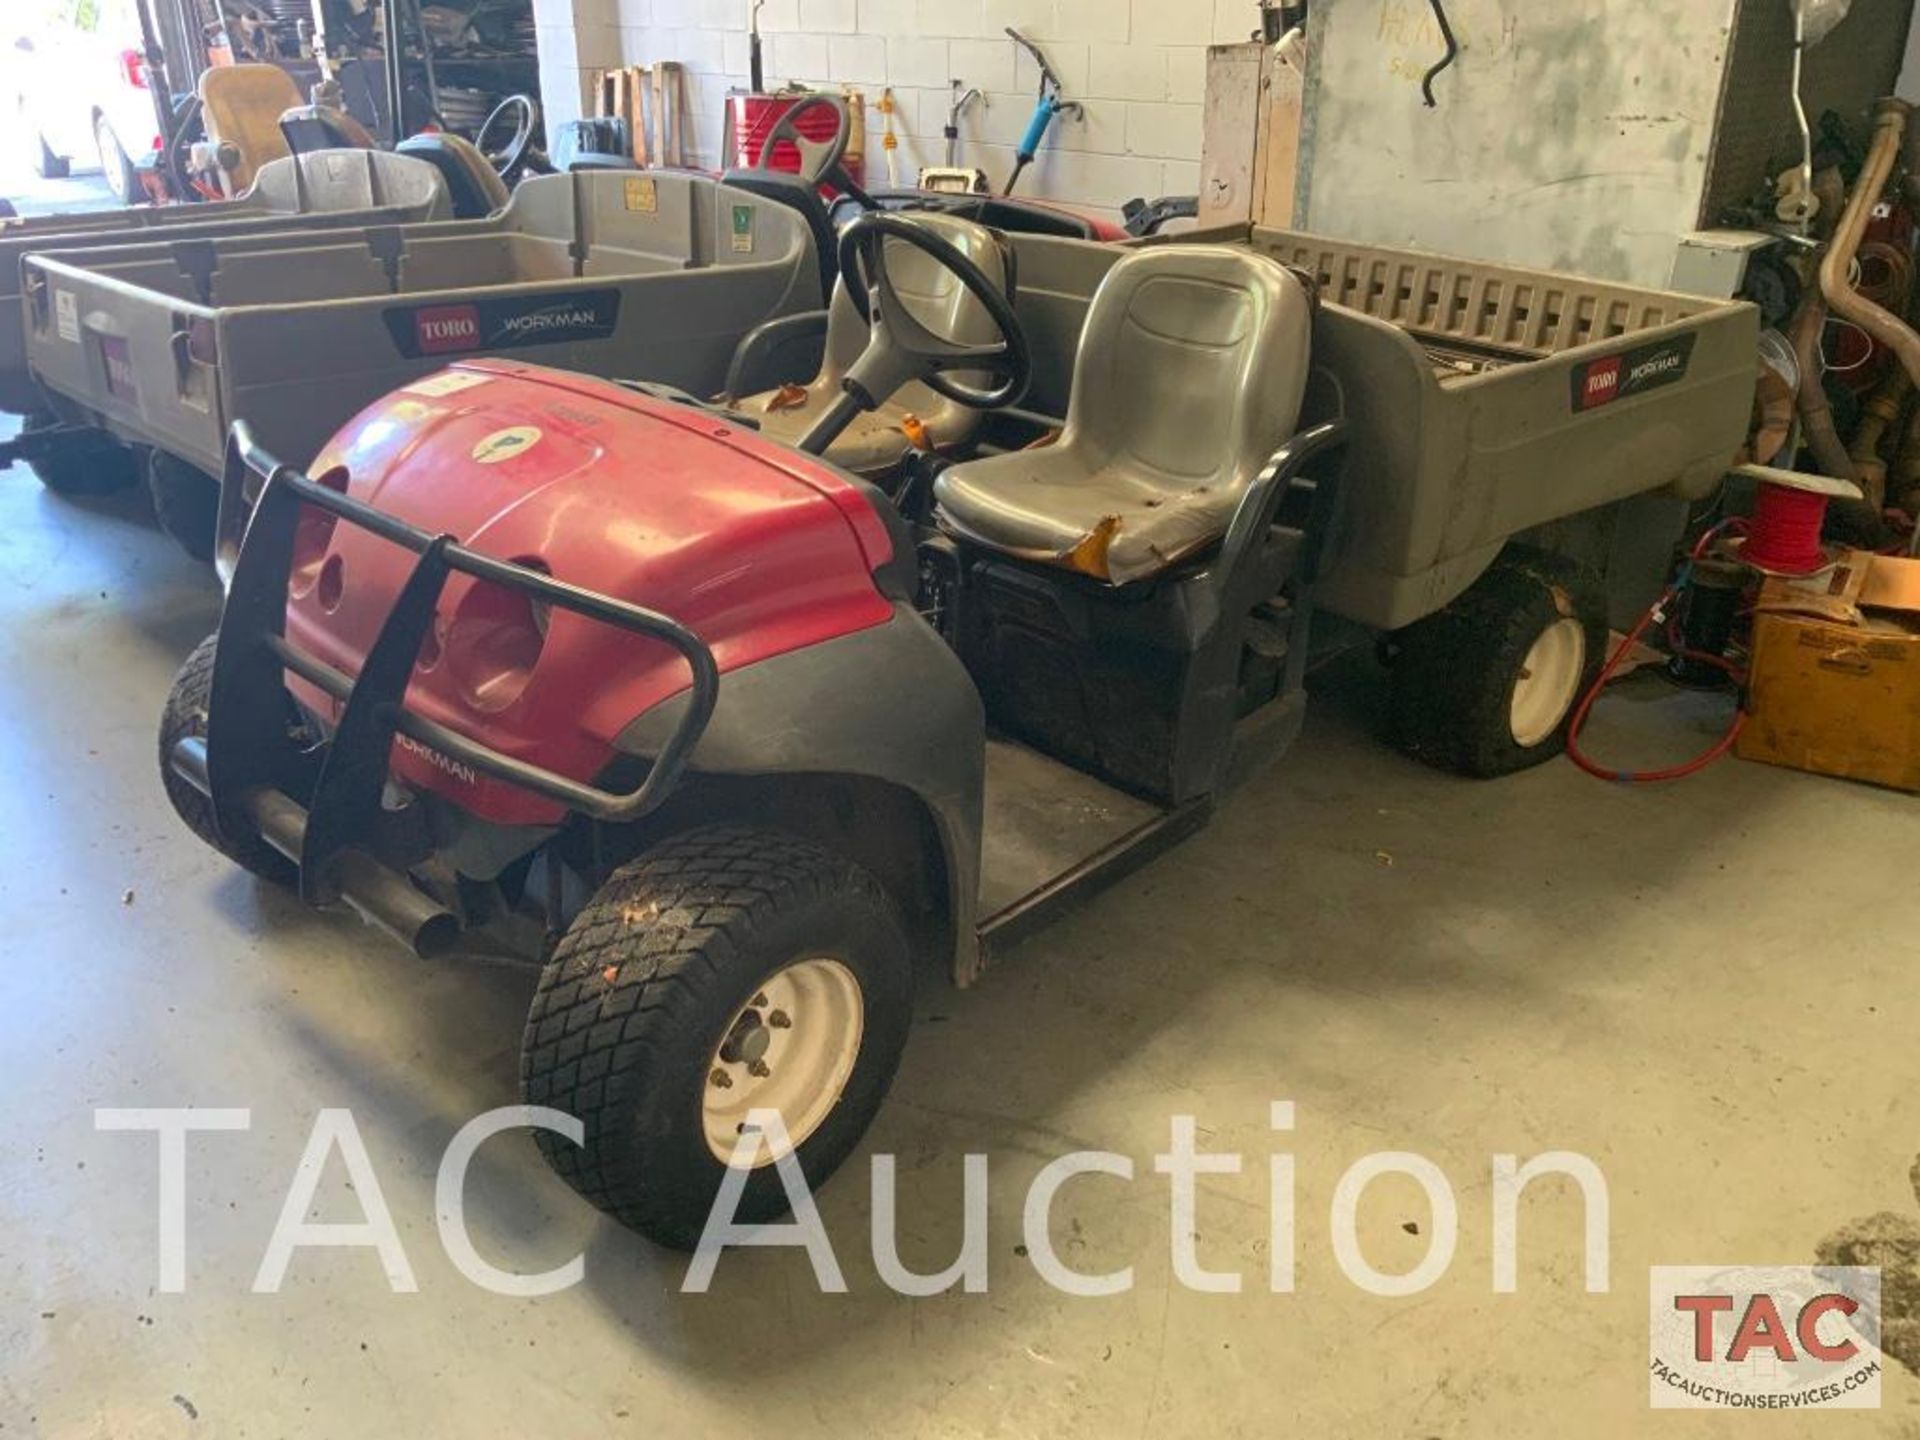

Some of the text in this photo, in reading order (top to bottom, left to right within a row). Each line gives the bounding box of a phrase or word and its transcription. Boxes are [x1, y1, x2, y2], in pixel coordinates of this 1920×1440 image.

[421, 310, 595, 340] TORO WORKMAN
[1588, 354, 1680, 393] TORO WORKMAN
